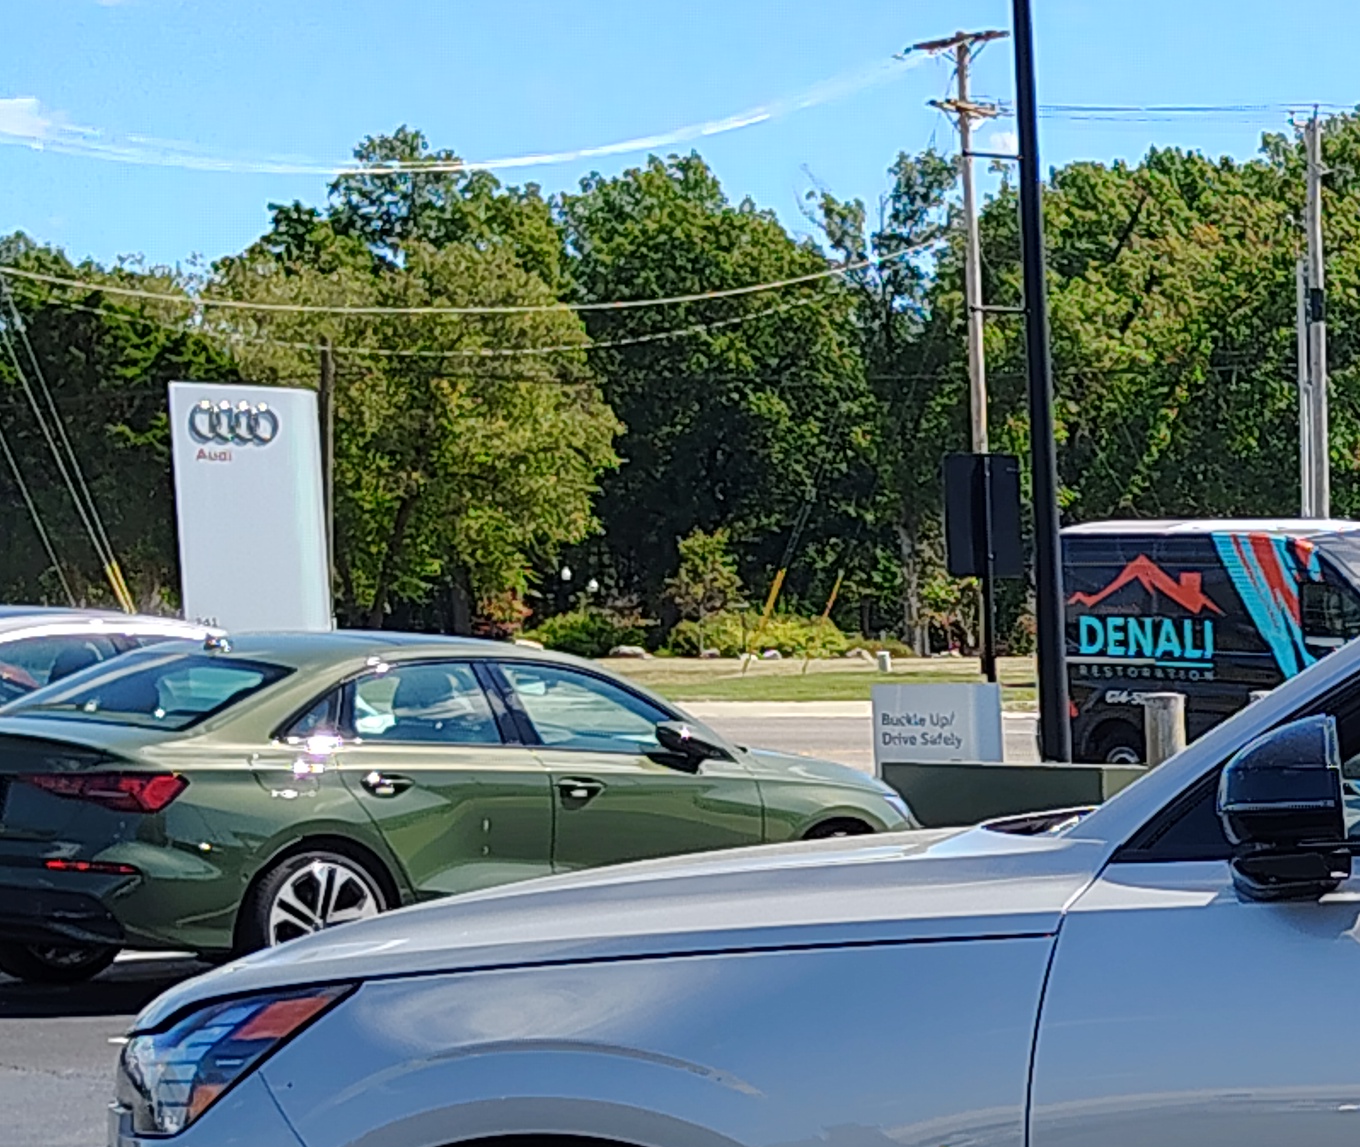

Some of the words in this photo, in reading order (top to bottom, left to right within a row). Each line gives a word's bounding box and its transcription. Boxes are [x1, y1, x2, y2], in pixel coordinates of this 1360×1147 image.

[195, 448, 233, 462] Audi
[1078, 615, 1214, 660] DENALI
[1078, 664, 1215, 681] RESTORATION
[881, 712, 926, 727] Buckle
[881, 732, 917, 747] Drive
[920, 732, 963, 749] Safely
